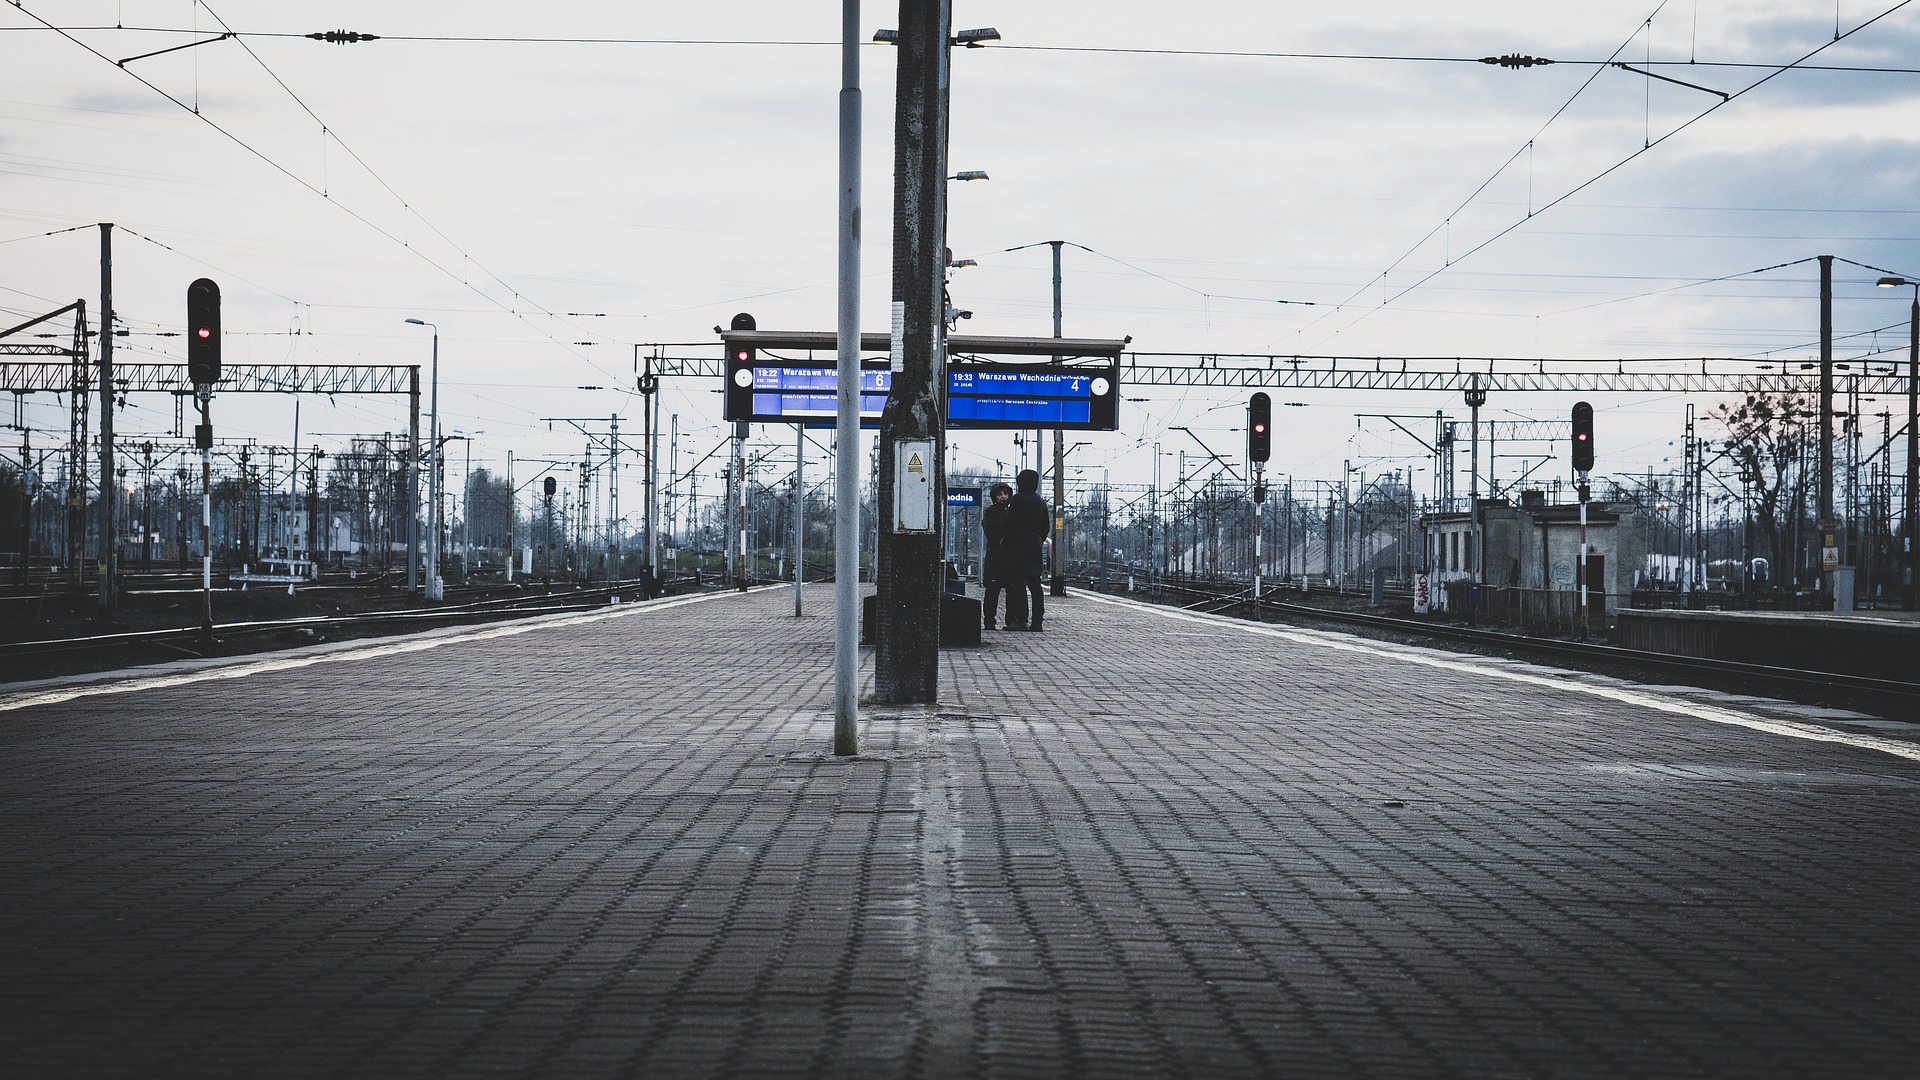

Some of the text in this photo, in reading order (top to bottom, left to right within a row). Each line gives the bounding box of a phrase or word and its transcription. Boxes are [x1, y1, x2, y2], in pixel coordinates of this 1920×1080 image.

[758, 369, 778, 377] 19:22
[782, 368, 822, 376] Warszawa
[875, 374, 884, 387] 6
[953, 373, 973, 381] 19:33
[978, 372, 1061, 381] Warszawa Wschodnia
[1071, 379, 1079, 392] 4
